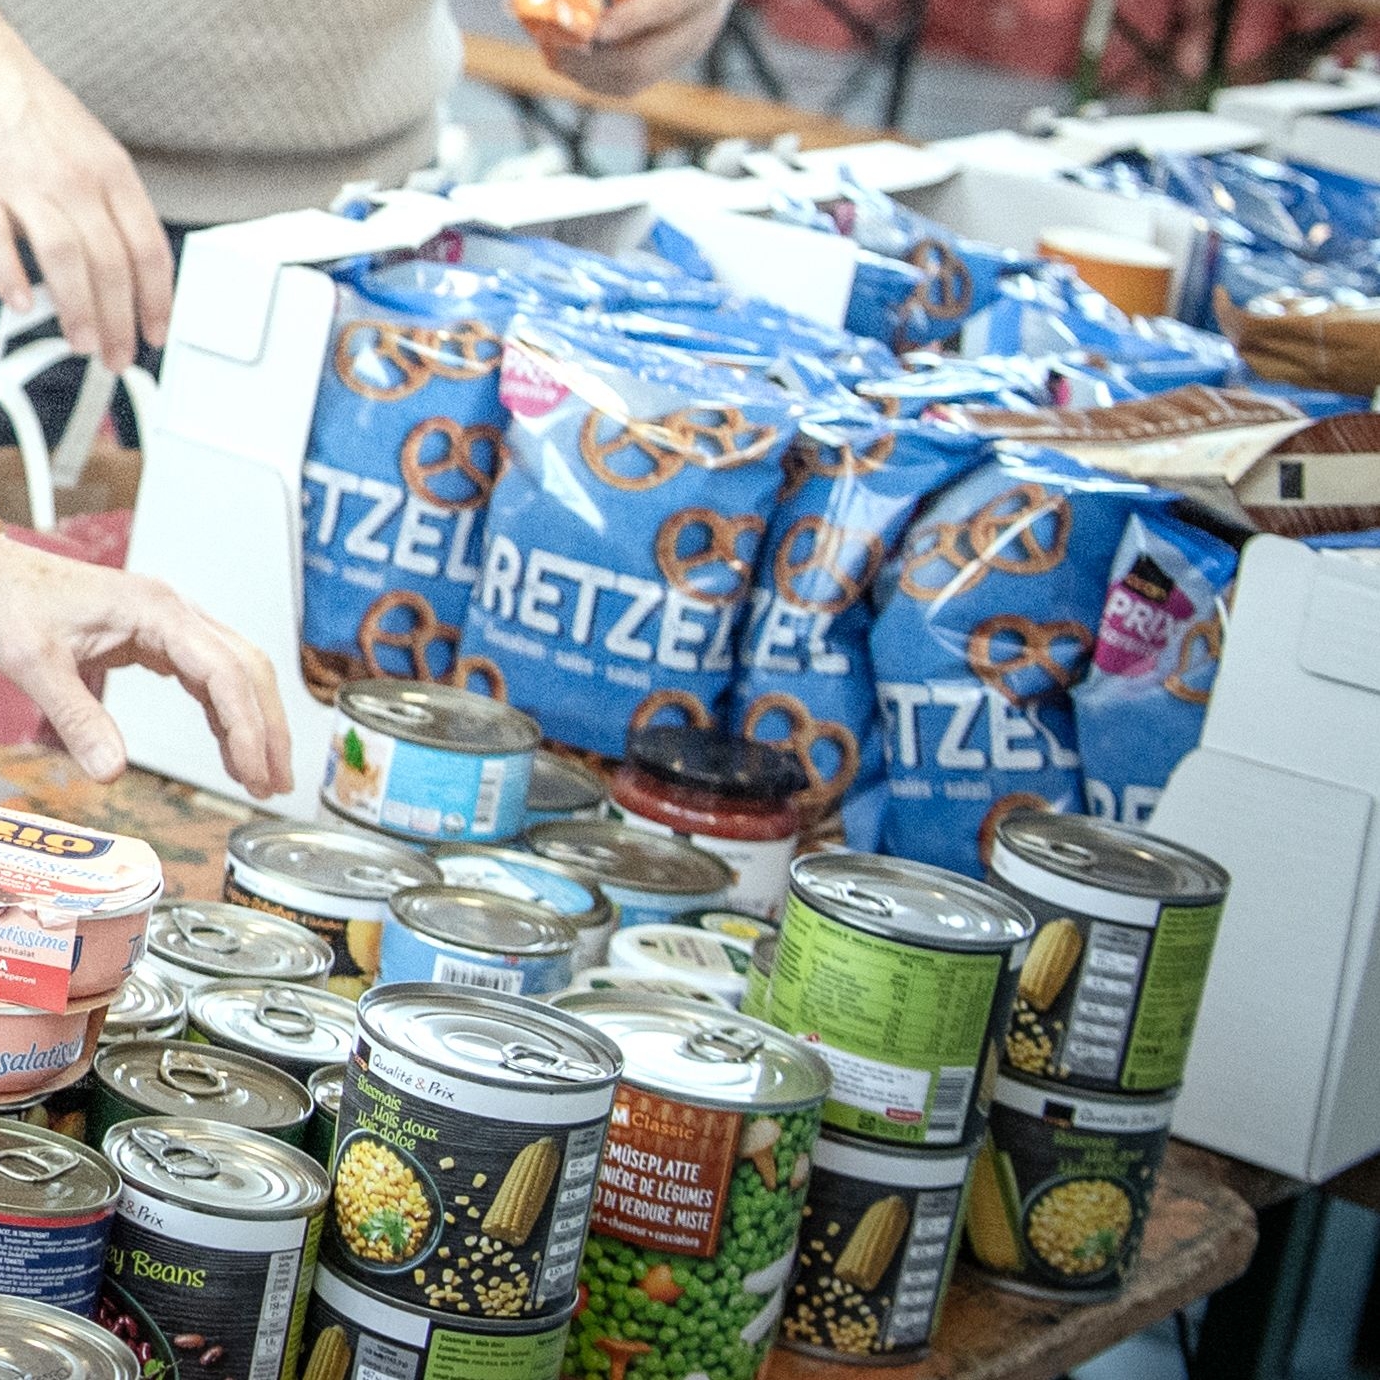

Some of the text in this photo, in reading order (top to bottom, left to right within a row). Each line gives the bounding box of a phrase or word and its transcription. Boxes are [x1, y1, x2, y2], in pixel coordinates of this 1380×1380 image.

[302, 466, 481, 583] TZEL
[480, 532, 733, 673] RETZEL
[0, 970, 37, 987] Peperoni
[372, 1053, 457, 1102] Qualité & Prix
[379, 1124, 417, 1151] dolce
[402, 1118, 440, 1141] doux
[631, 1111, 695, 1141] Classic
[638, 1176, 655, 1198] DE
[656, 1179, 714, 1209] LÉGUMES
[137, 1205, 164, 1229] Prix
[603, 1190, 713, 1232] DI VERDURE MISTE
[131, 1250, 206, 1288] Beans
